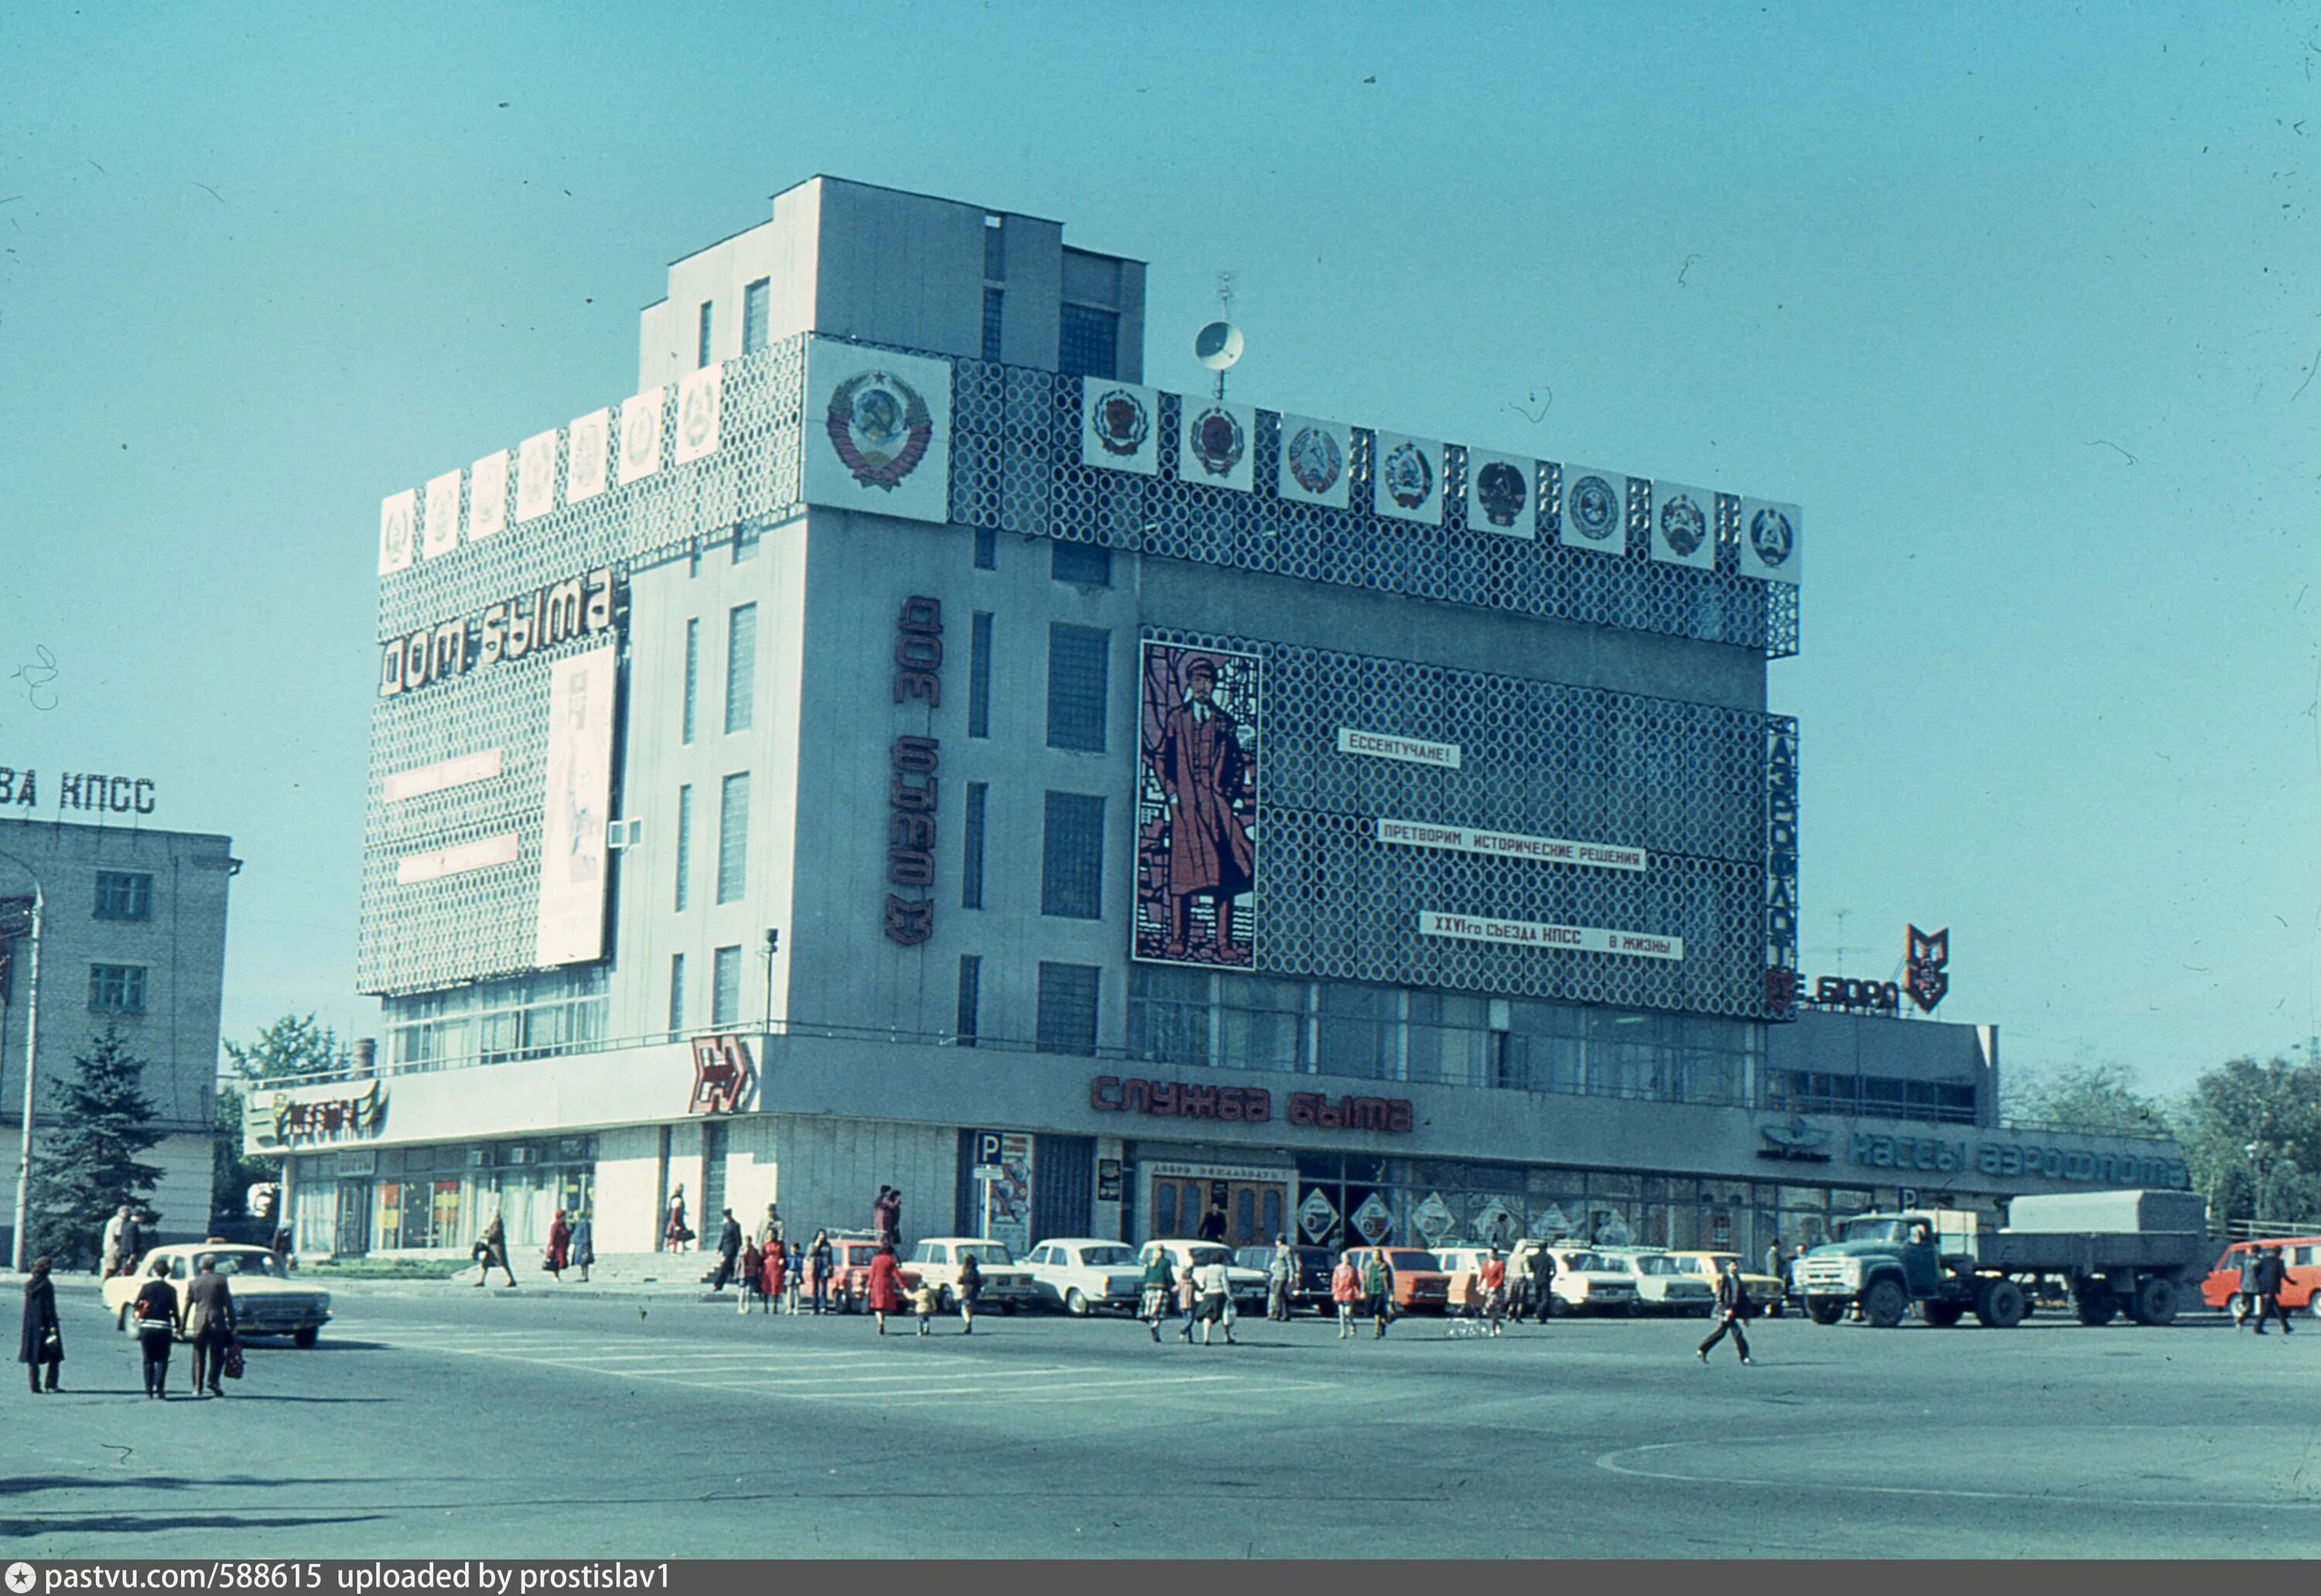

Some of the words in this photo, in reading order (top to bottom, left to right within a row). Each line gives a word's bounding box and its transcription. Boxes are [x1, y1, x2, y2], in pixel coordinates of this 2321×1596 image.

[1349, 733, 1450, 762] ЕССЕНТУЧАНЕ!
[60, 772, 156, 814] КПСС
[1383, 824, 1461, 846] ПРЕТВОРИМ
[1473, 834, 1574, 859] ИСТОРИЧЕСКИЕ
[1579, 847, 1640, 866] РЕШЕНИЯ
[1485, 923, 1537, 942] СЪЕЗДА
[1609, 935, 1617, 948] В
[983, 1134, 1000, 1162] P
